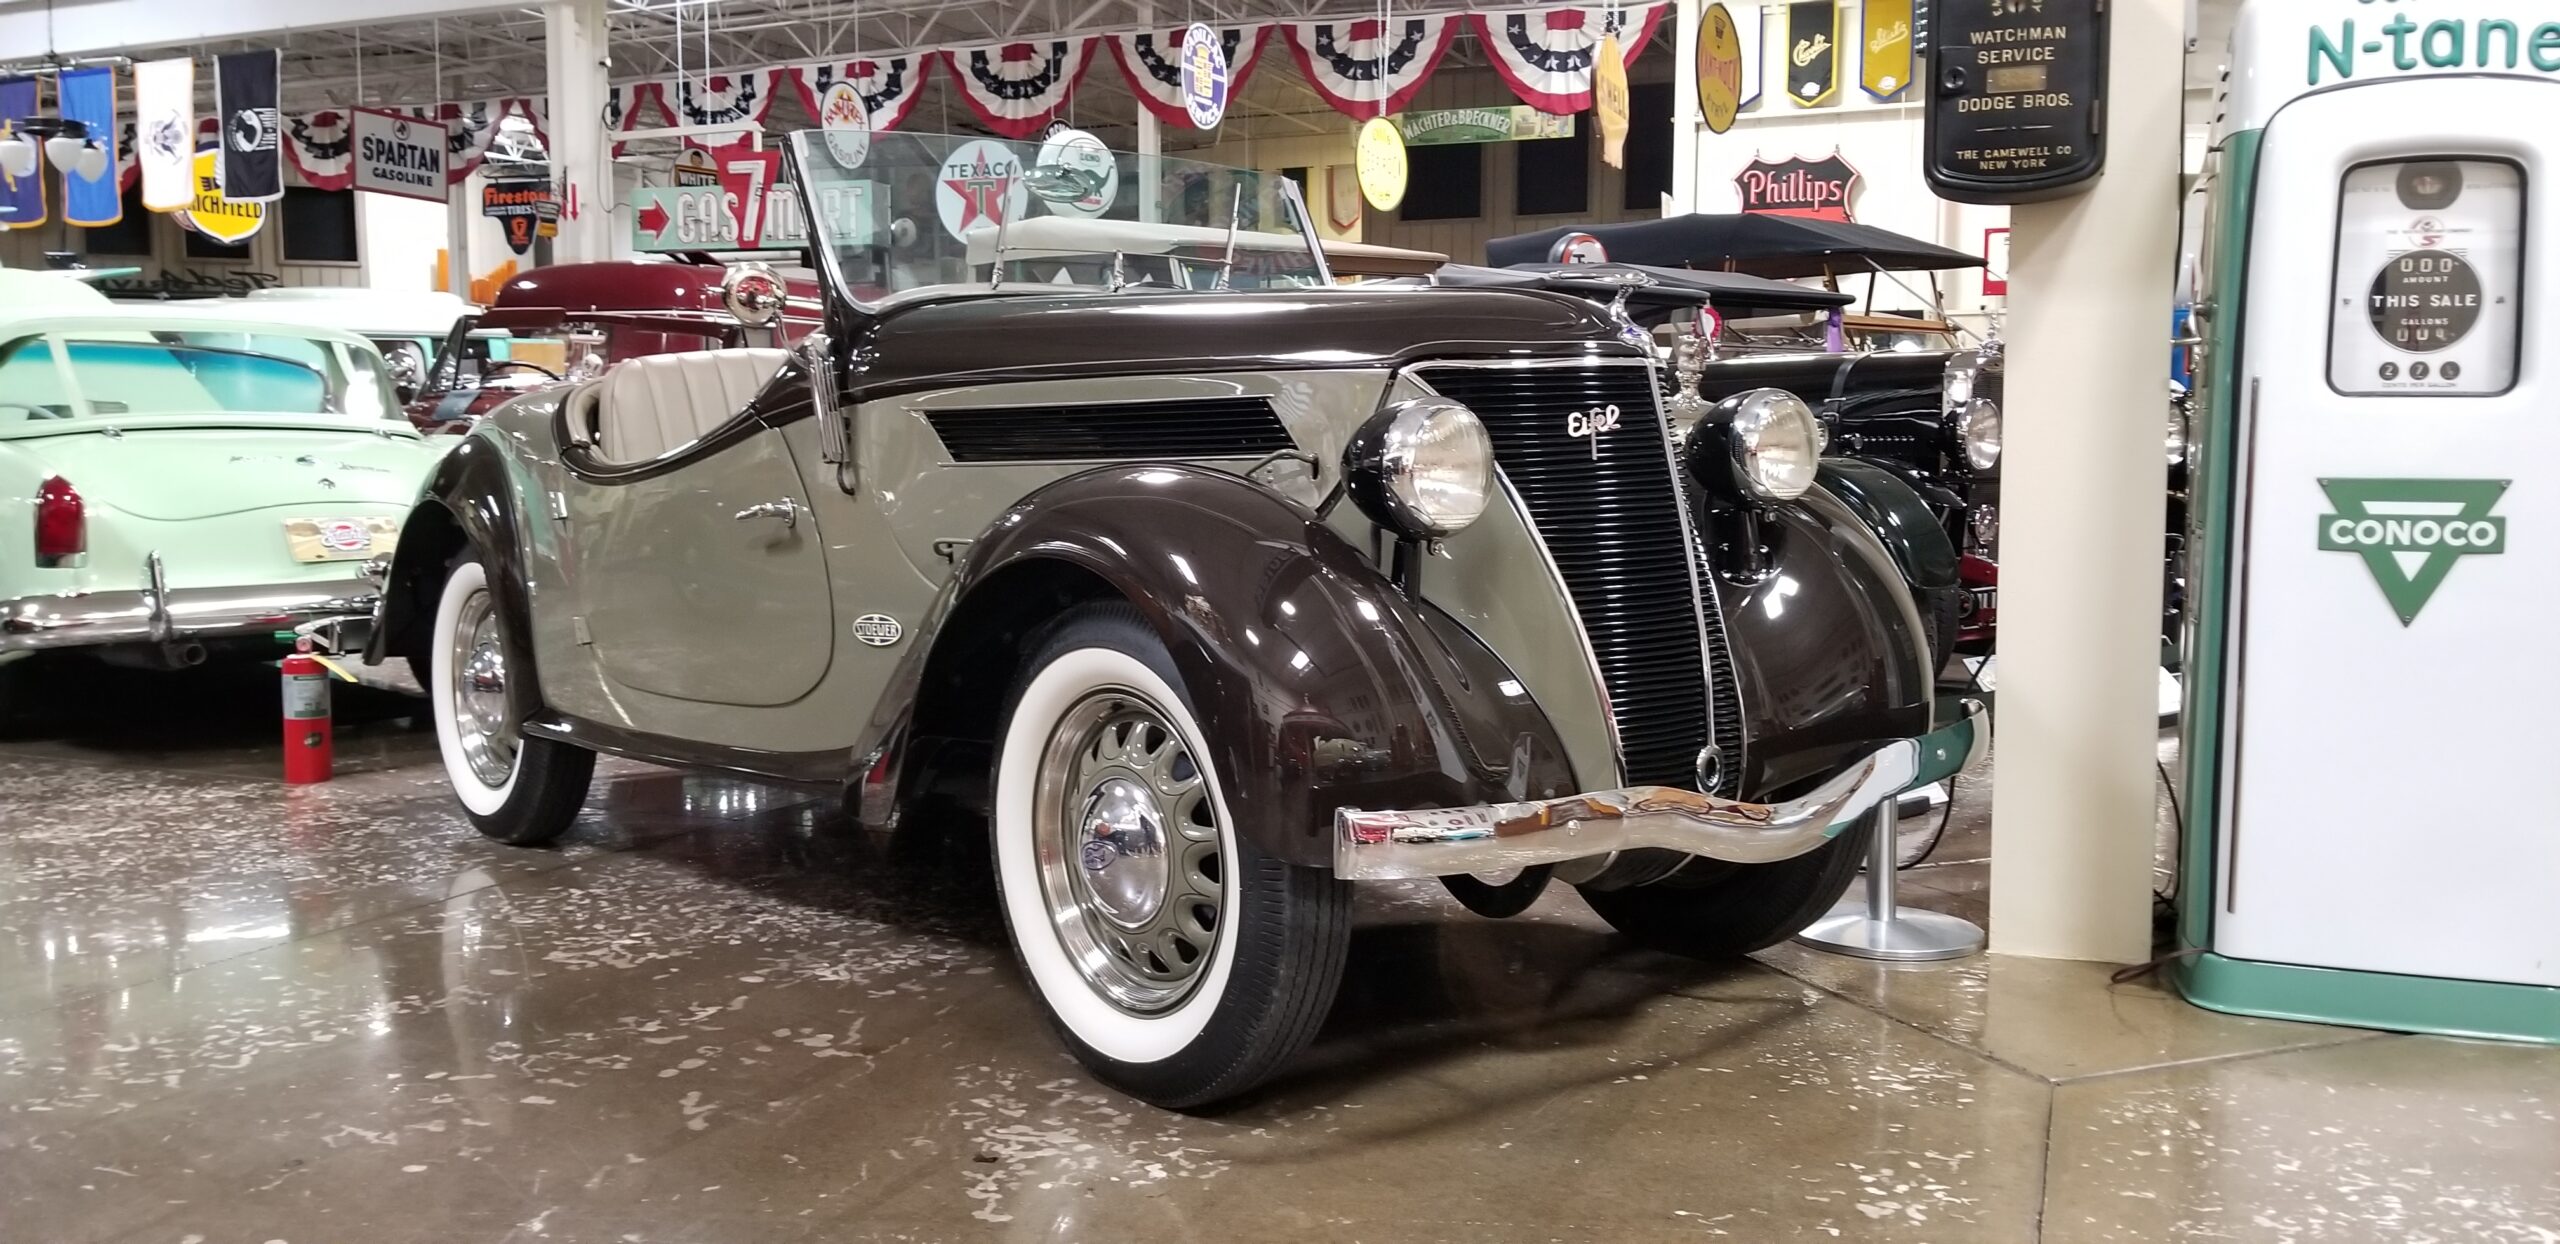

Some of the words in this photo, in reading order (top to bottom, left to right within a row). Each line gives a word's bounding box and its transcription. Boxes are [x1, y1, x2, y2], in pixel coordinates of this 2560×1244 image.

[1970, 26, 2067, 45] WATCHMAN
[1185, 27, 1223, 69] CADILLAC
[1977, 47, 2055, 64] SERVICE
[2308, 13, 2560, 86] N-tane
[1958, 96, 2016, 113] DODGE
[2023, 93, 2073, 109] BROS.
[362, 135, 440, 174] SPARTAN
[1956, 150, 1979, 160] THE
[1979, 160, 2008, 170] NEW
[2013, 158, 2047, 168] YORK
[372, 166, 433, 187] GASOLINE
[948, 162, 1018, 178] TEXACO
[680, 174, 717, 186] WHITE
[1743, 169, 1843, 212] Phillips
[188, 194, 263, 219] ICHFIELD
[676, 193, 739, 243] GAS
[766, 188, 864, 241] MRT
[2402, 275, 2449, 284] AMOUNT
[2372, 295, 2420, 308] THIS
[2430, 294, 2477, 307] SALE
[2401, 317, 2449, 326] GALLONS
[2329, 518, 2497, 547] CONOCO
[856, 623, 898, 637] STOEWER
